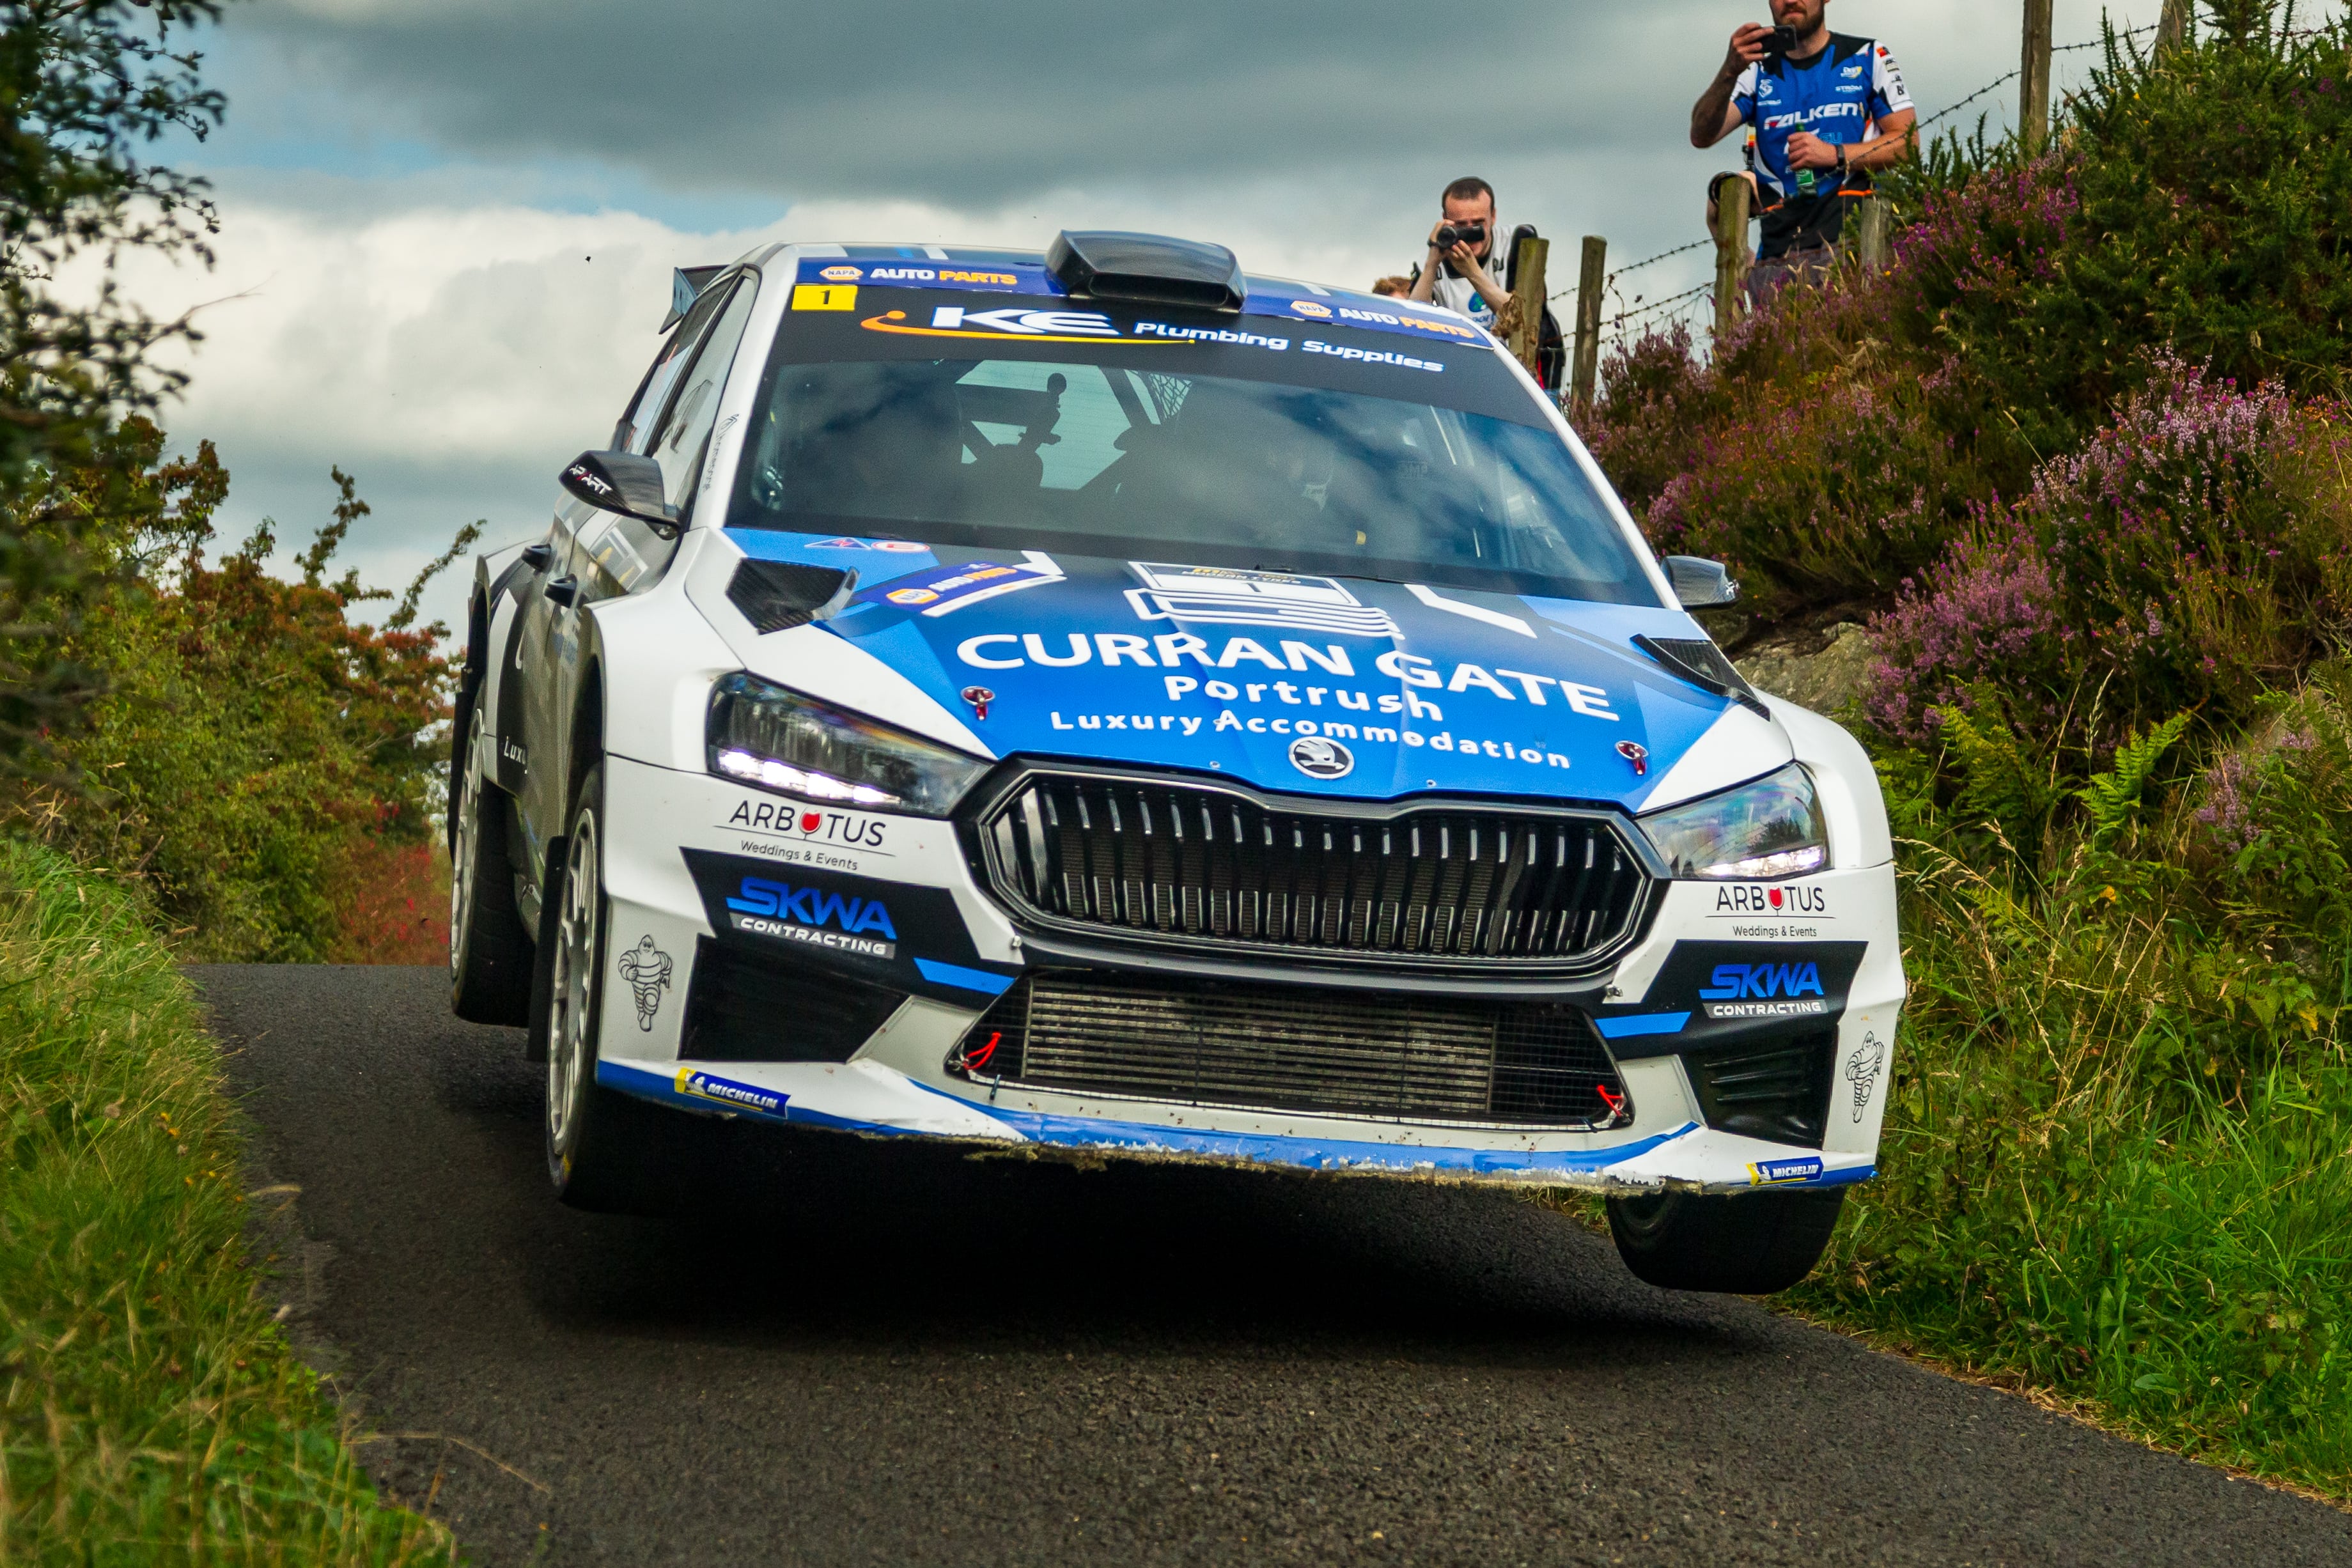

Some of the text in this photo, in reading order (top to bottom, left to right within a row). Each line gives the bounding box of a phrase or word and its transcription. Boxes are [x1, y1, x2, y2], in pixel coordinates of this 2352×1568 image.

[1763, 102, 1858, 130] FALKEN
[827, 268, 1018, 285] NAPA AUTO PARTS
[818, 290, 830, 306] 1
[1297, 303, 1327, 314] NAPA
[1339, 307, 1399, 325] AUTO
[1399, 316, 1475, 339] PARTS
[1134, 322, 1445, 372] Plumbing Supplies
[956, 632, 1619, 721] CURRAN GATE
[1164, 676, 1444, 721] Portrush
[1050, 709, 1570, 769] Luxury Accommodation
[740, 839, 859, 871] Weddings & Events
[726, 876, 898, 940] SKWA
[740, 917, 887, 956] CONTRACTING
[1733, 925, 1818, 938] Weddings & Events
[1699, 961, 1824, 999] SKWA
[1713, 1002, 1822, 1016] CONTRACTING
[707, 1083, 779, 1109] MICHELIN
[1773, 1163, 1819, 1178] MICHELIN
